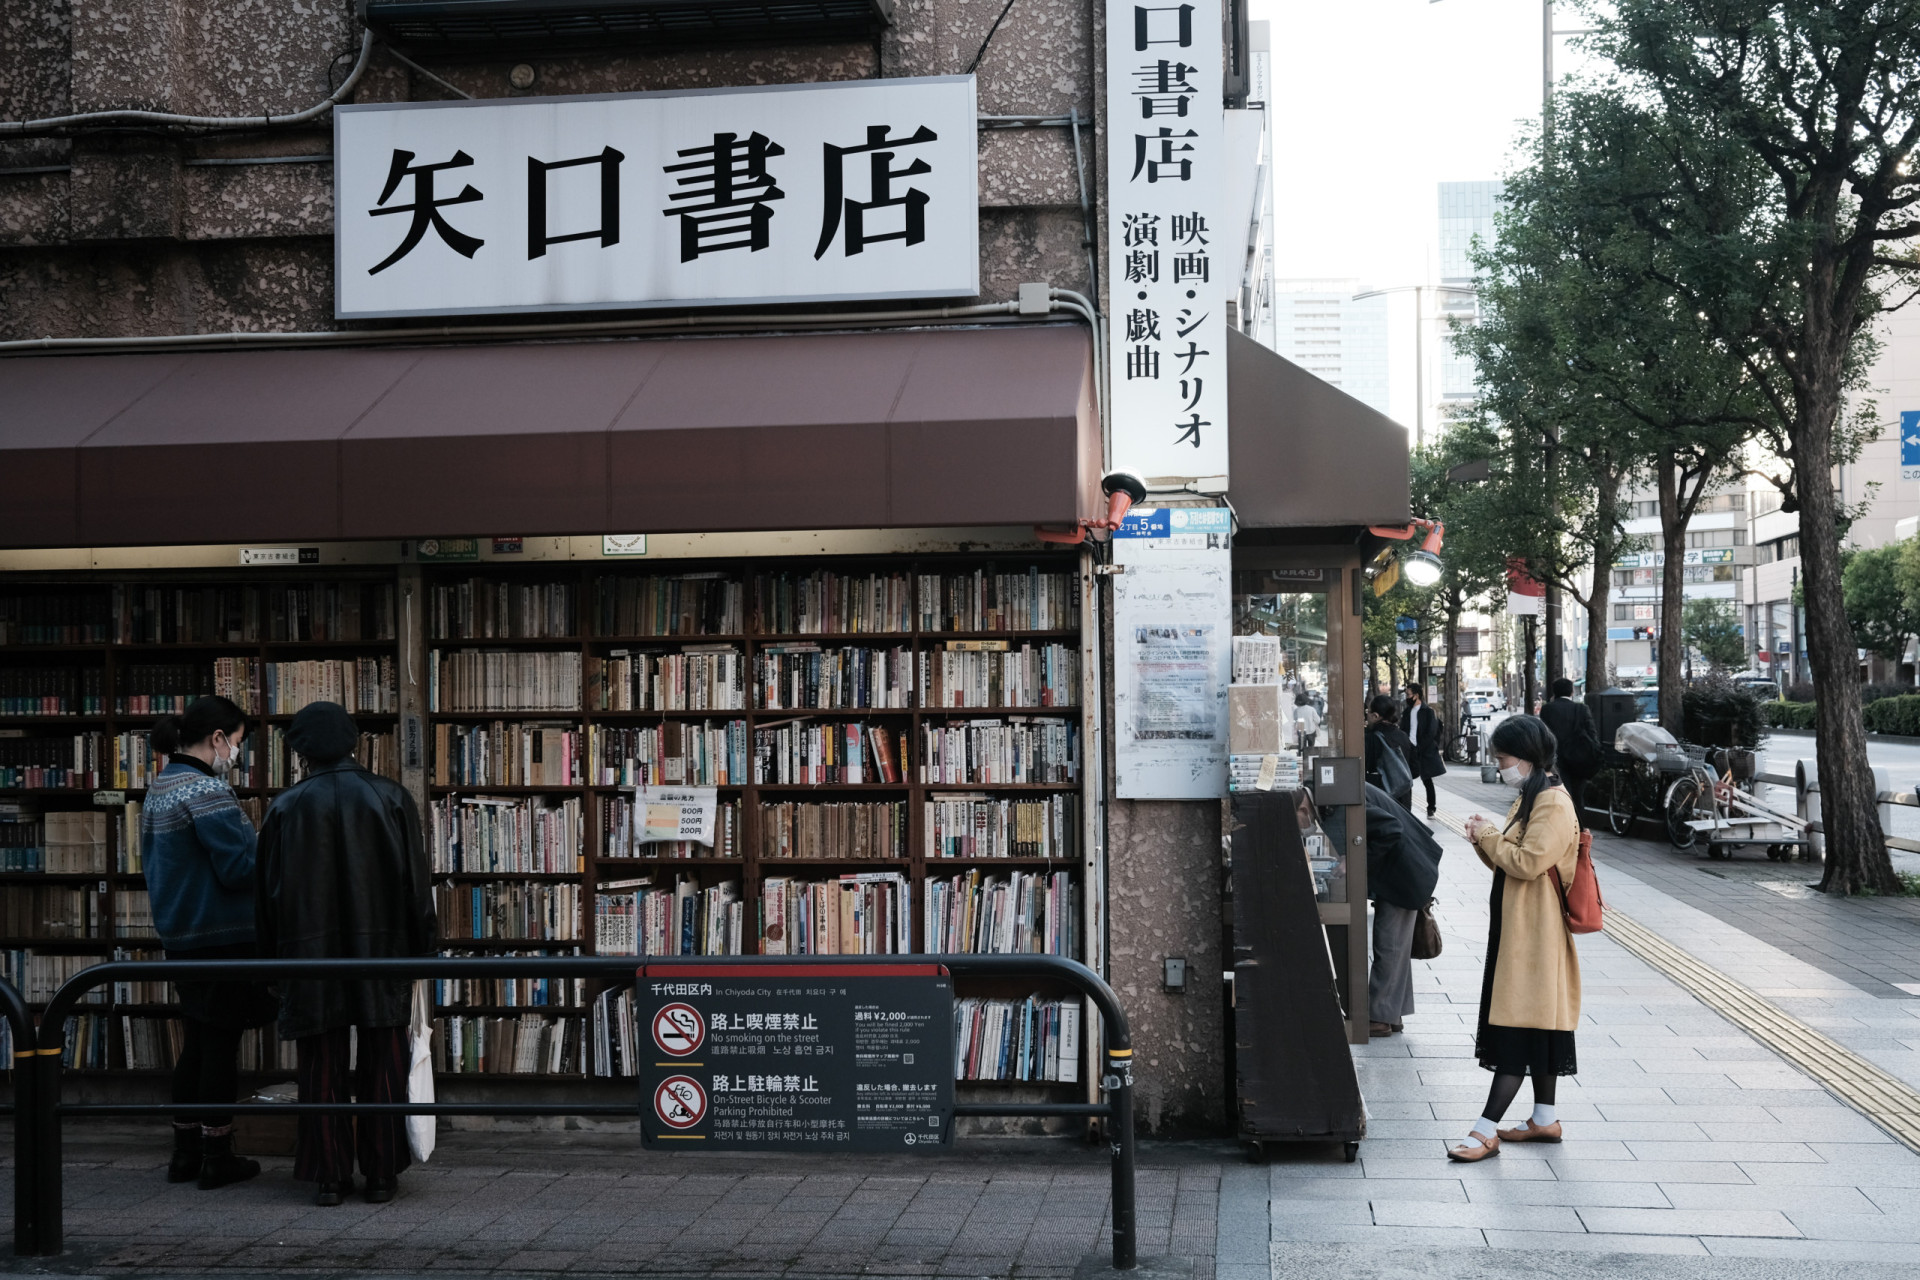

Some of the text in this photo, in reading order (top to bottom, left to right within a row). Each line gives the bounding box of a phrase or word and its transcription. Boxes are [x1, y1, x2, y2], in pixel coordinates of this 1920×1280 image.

[1130, 3, 1199, 184] 口書店
[367, 124, 938, 276] 矢口書店
[1121, 211, 1162, 381] 演劇・戯曲
[1170, 210, 1212, 449] 映画・シナリオ
[494, 543, 523, 552] SECOM
[253, 552, 297, 560] 東京古書組合
[681, 807, 703, 815] 800円
[681, 817, 702, 825] 500円
[680, 827, 702, 835] 200円
[650, 983, 712, 996] 千代田区内
[725, 988, 755, 997] Chiyoda
[757, 988, 772, 997] City
[711, 1012, 819, 1031] 路上喫煙禁止
[874, 1011, 907, 1021] ¥2,000
[711, 1033, 724, 1042] No
[726, 1033, 763, 1045] smoking
[777, 1033, 792, 1042] the
[794, 1034, 819, 1042] street
[773, 1045, 791, 1055] 노상
[815, 1045, 834, 1055] 금지
[712, 1074, 819, 1092] 路上駐輪禁止
[713, 1094, 832, 1106] On-Street Bicycle & Scooter
[713, 1106, 793, 1118] Parking Prohibited
